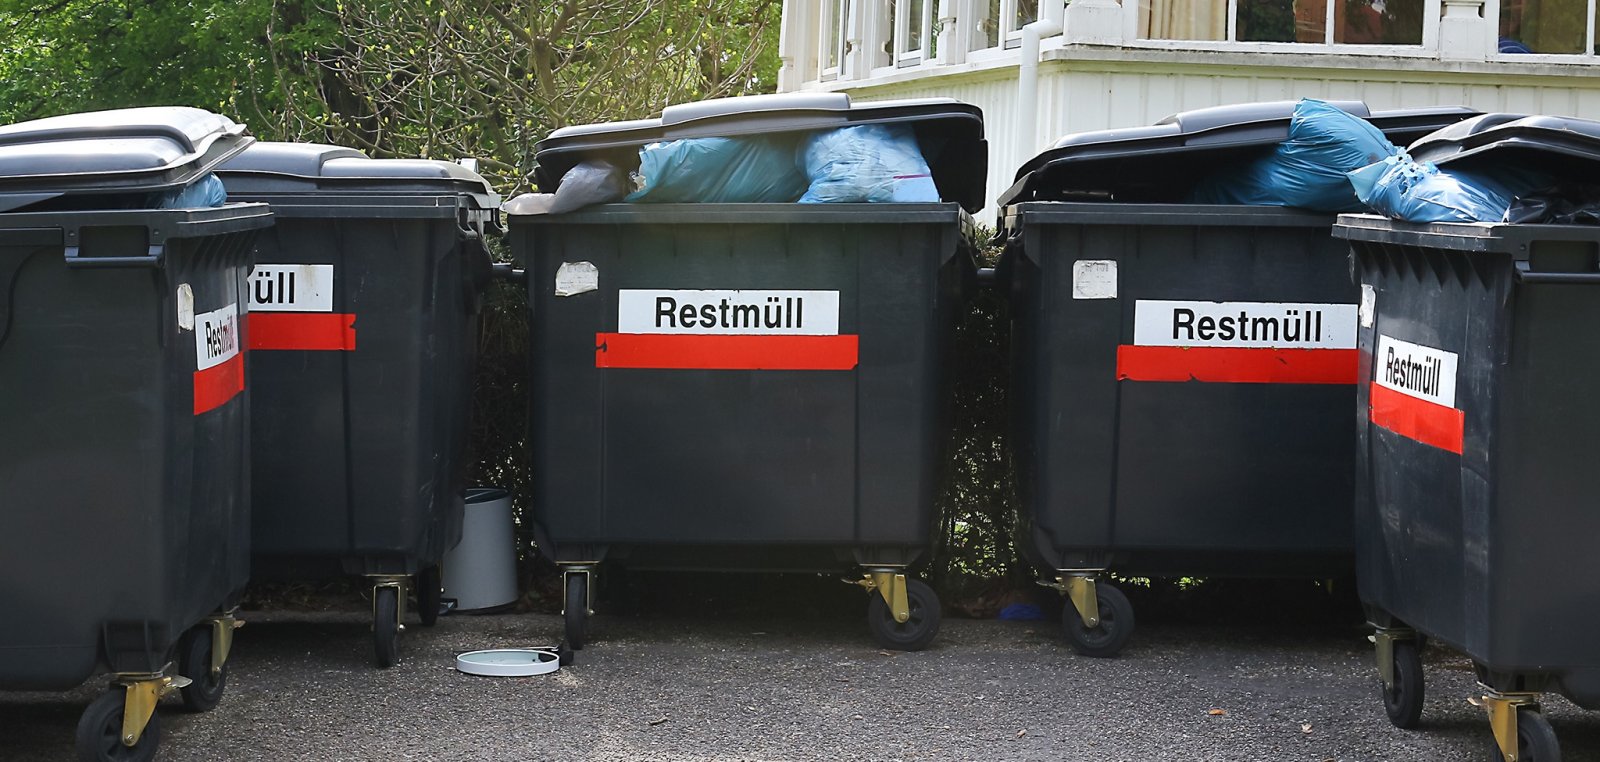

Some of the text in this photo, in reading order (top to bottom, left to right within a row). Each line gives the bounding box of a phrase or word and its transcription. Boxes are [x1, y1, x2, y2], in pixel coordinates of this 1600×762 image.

[248, 271, 295, 304] üll
[655, 296, 803, 328] Restmüll
[1173, 308, 1322, 342] Restmüll
[1385, 346, 1441, 397] Restmüll
